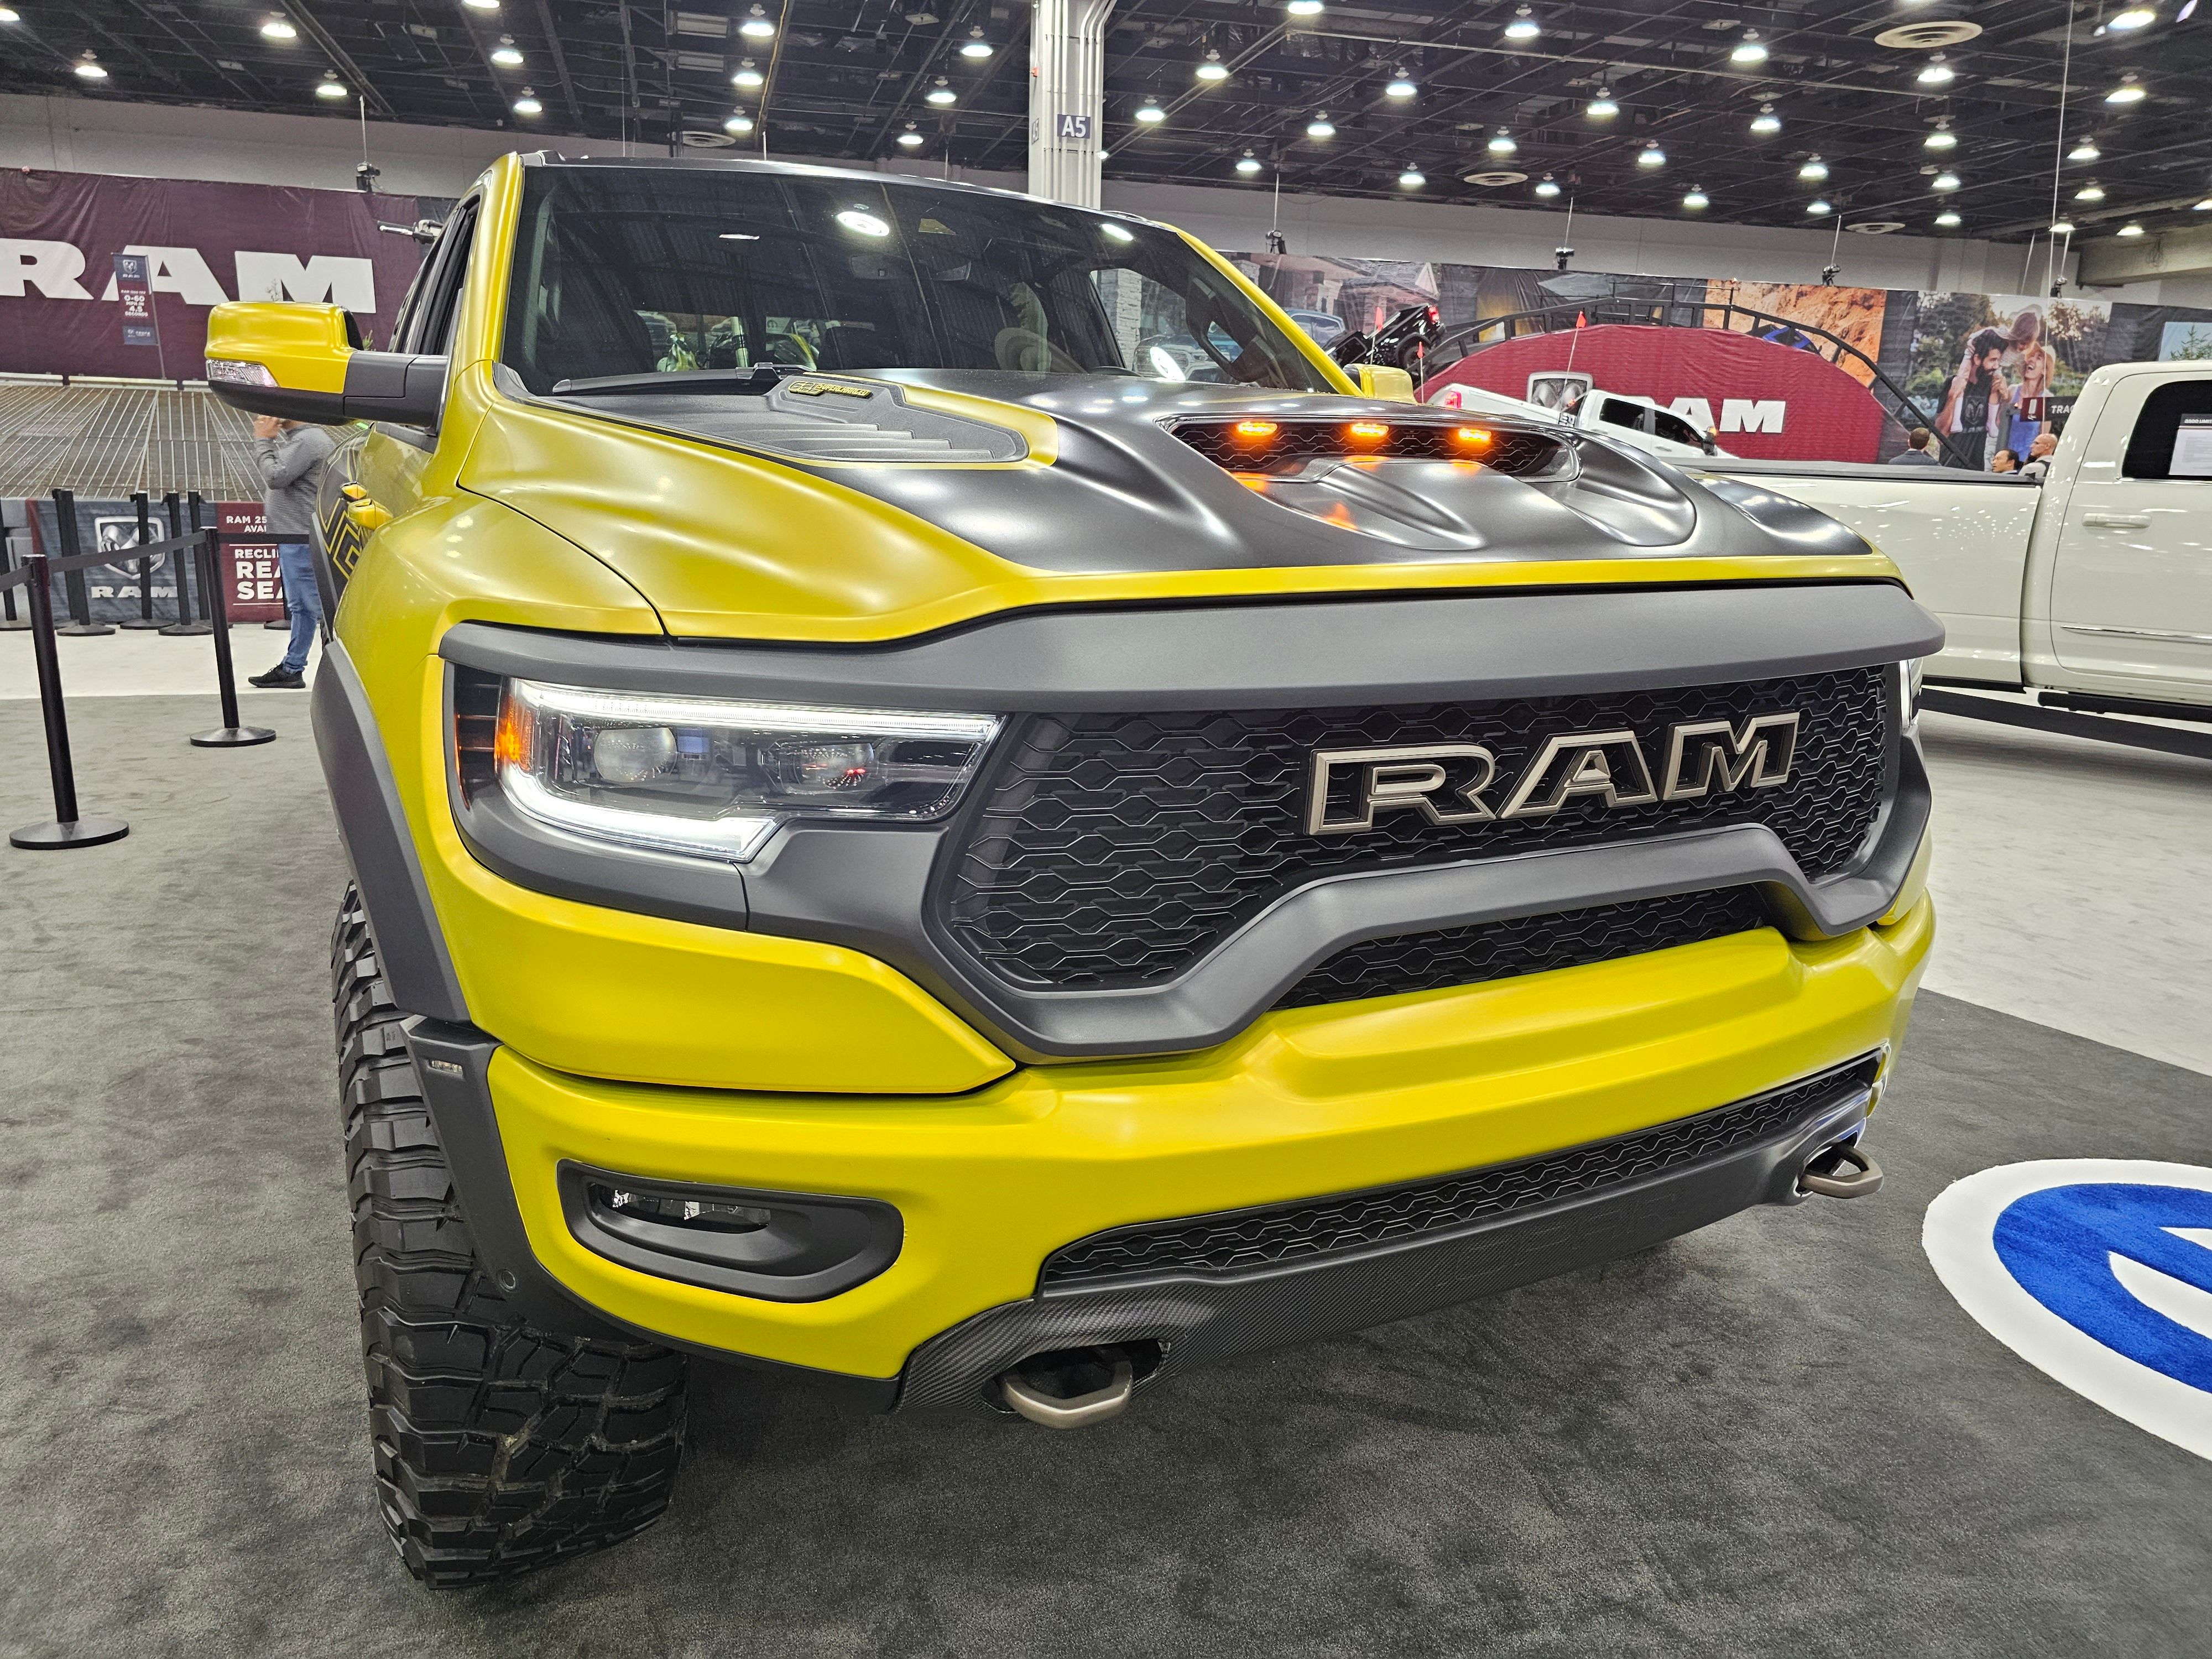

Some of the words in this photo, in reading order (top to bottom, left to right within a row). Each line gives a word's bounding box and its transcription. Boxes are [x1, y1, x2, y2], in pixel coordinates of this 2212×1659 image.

[1061, 116, 1086, 138] A5
[0, 238, 376, 314] RAM
[816, 383, 872, 397] SUPERCHARGED
[226, 515, 251, 524] RAM
[91, 586, 178, 598] RAM
[1304, 712, 1799, 835] RAM
